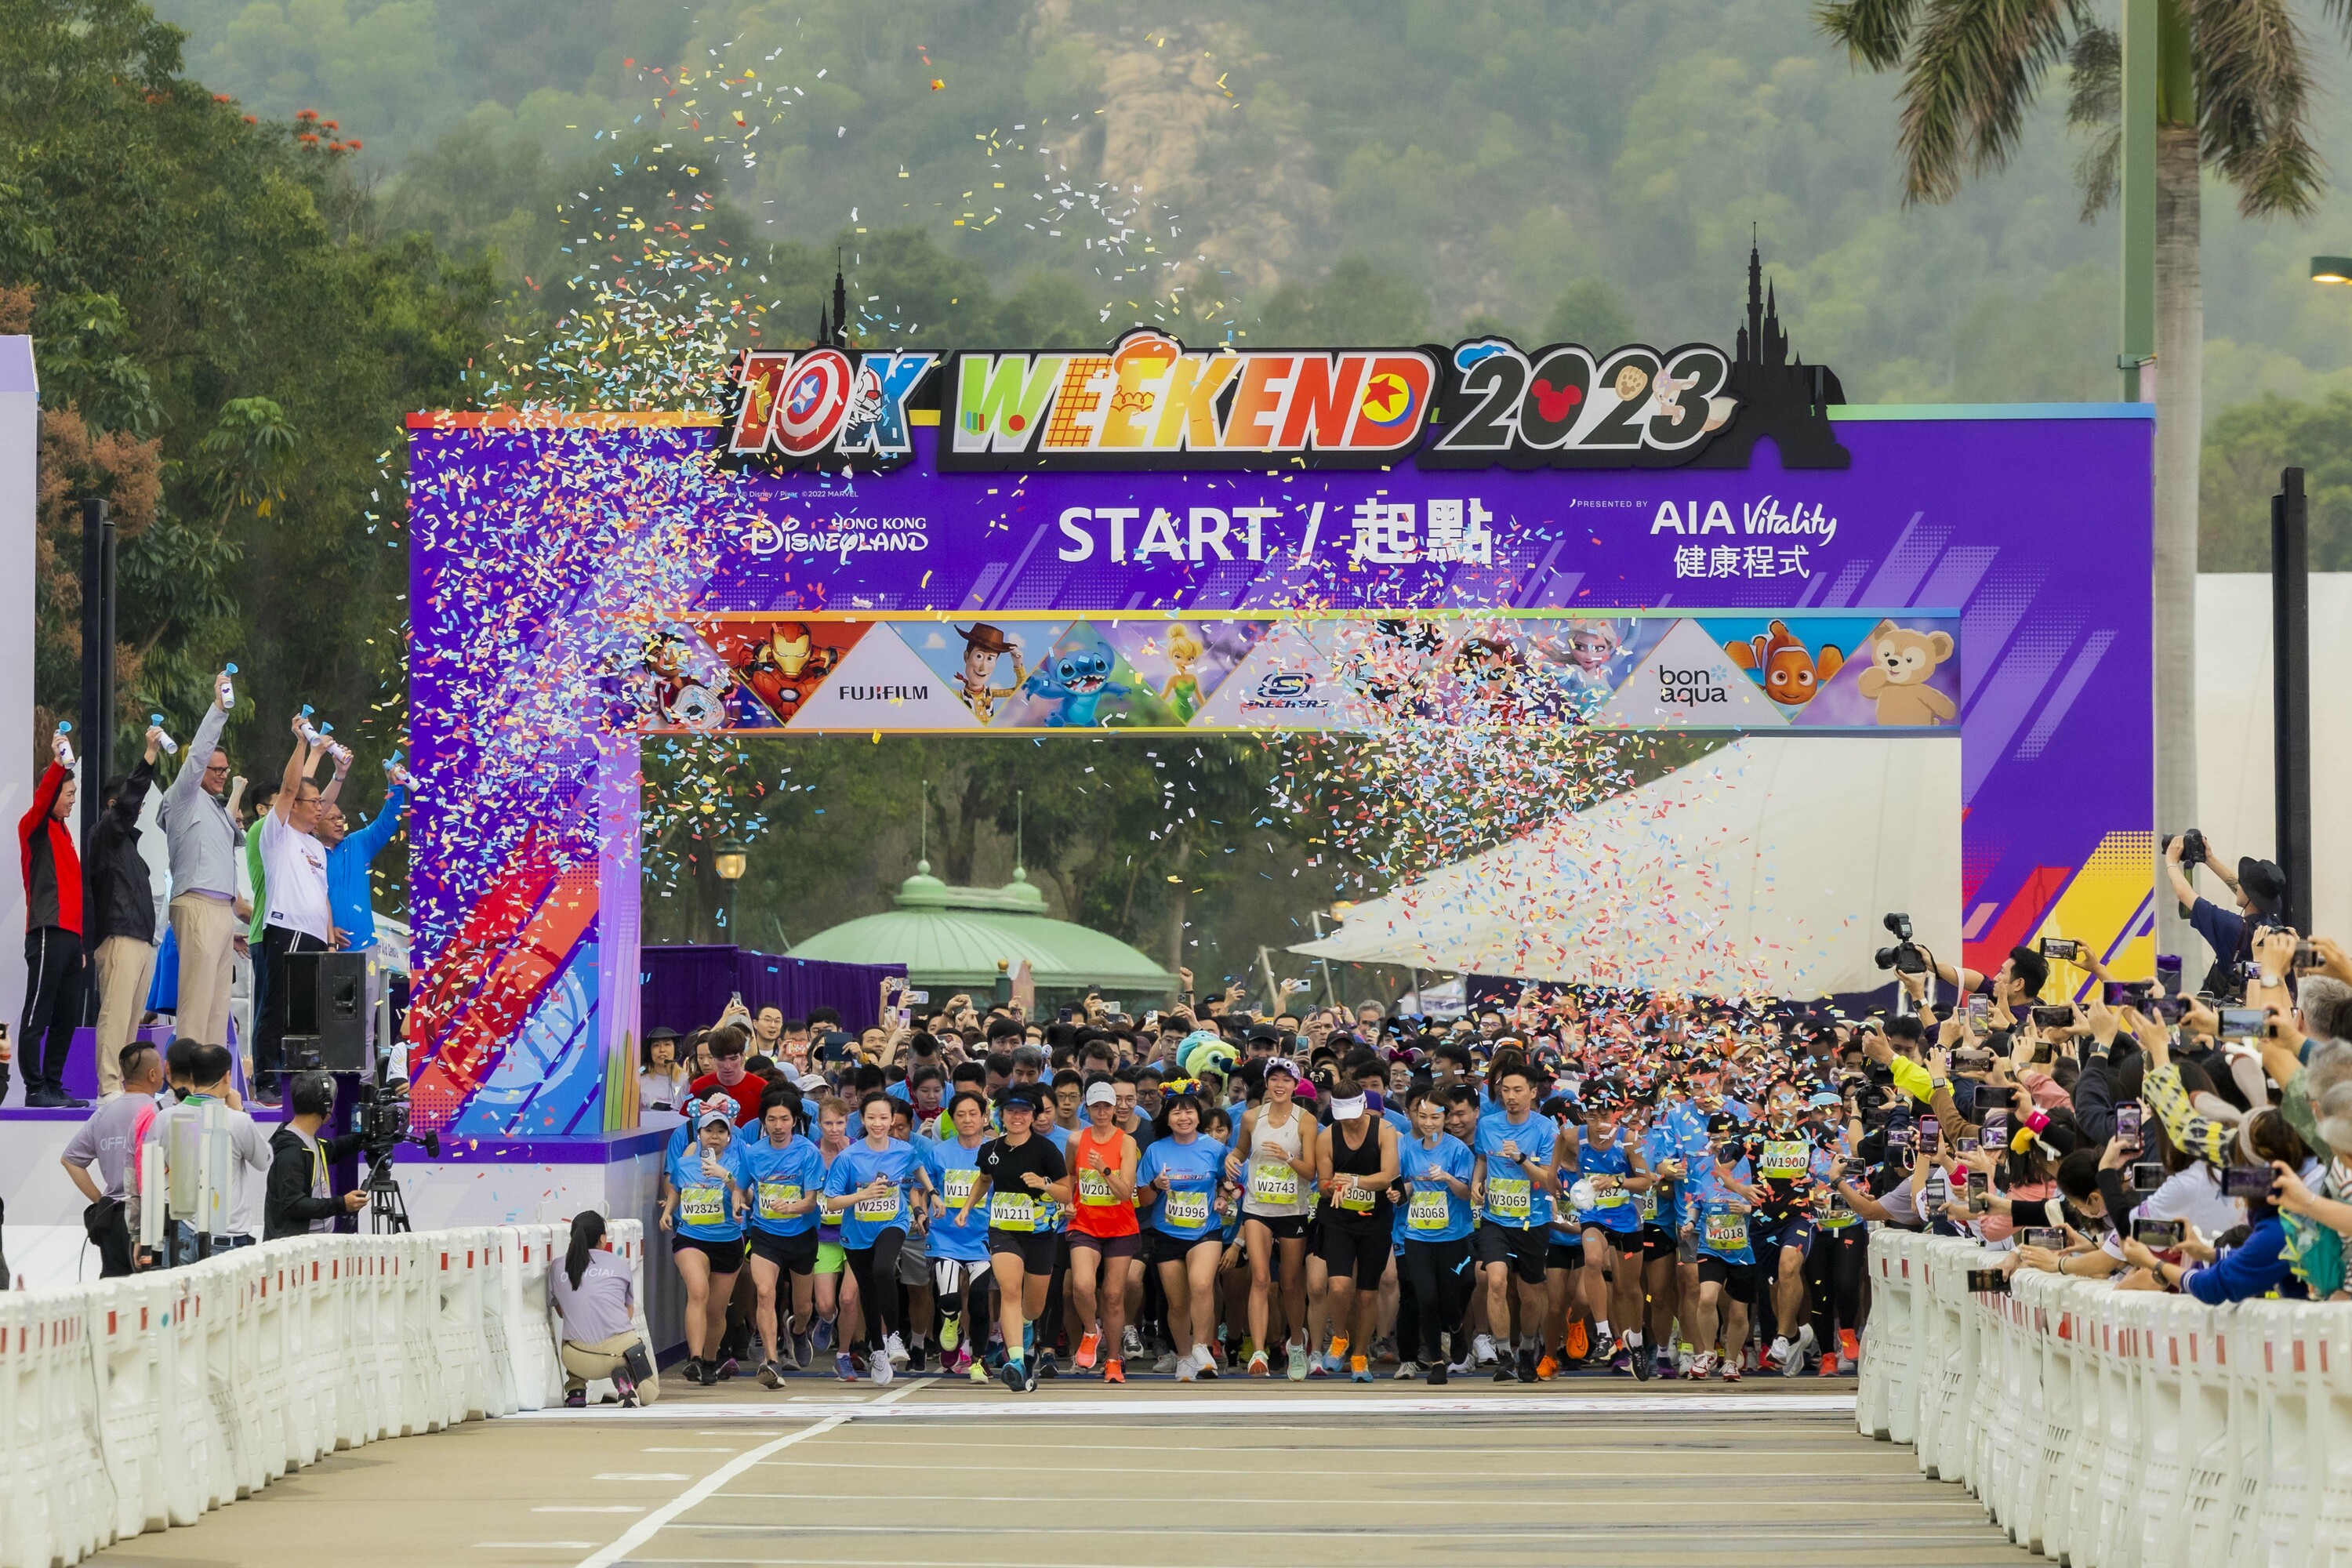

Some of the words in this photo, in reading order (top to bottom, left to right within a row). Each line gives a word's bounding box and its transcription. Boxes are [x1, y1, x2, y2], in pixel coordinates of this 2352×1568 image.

[728, 349, 939, 456] 10K
[953, 351, 1432, 453] WEEKEND
[1435, 346, 1724, 451] 2023
[832, 517, 877, 530] HONG
[883, 517, 927, 530] KONG
[1650, 500, 1736, 535] AIA
[1744, 495, 1837, 546] Vitality
[1058, 507, 1277, 561] START
[1301, 502, 1326, 565] /
[1352, 498, 1492, 564] 起點
[1674, 544, 1810, 579] 健康程式
[1660, 665, 1710, 685] bon
[840, 686, 928, 700] FUJIFILM
[1661, 688, 1727, 707] aqua
[100, 1137, 127, 1151] OFFI
[1766, 1157, 1806, 1167] W1900
[947, 1185, 970, 1196] W11
[1082, 1183, 1111, 1196] W201
[1258, 1181, 1295, 1193] W2743
[1598, 1188, 1619, 1198] 282
[1346, 1189, 1372, 1201] 3090
[1490, 1194, 1526, 1207] W3069
[684, 1203, 720, 1214] W2825
[858, 1200, 896, 1212] W2598
[1168, 1203, 1205, 1218] W1996
[1411, 1207, 1445, 1218] W3068
[994, 1207, 1031, 1220] W1211
[561, 1268, 618, 1283] OICIAL
